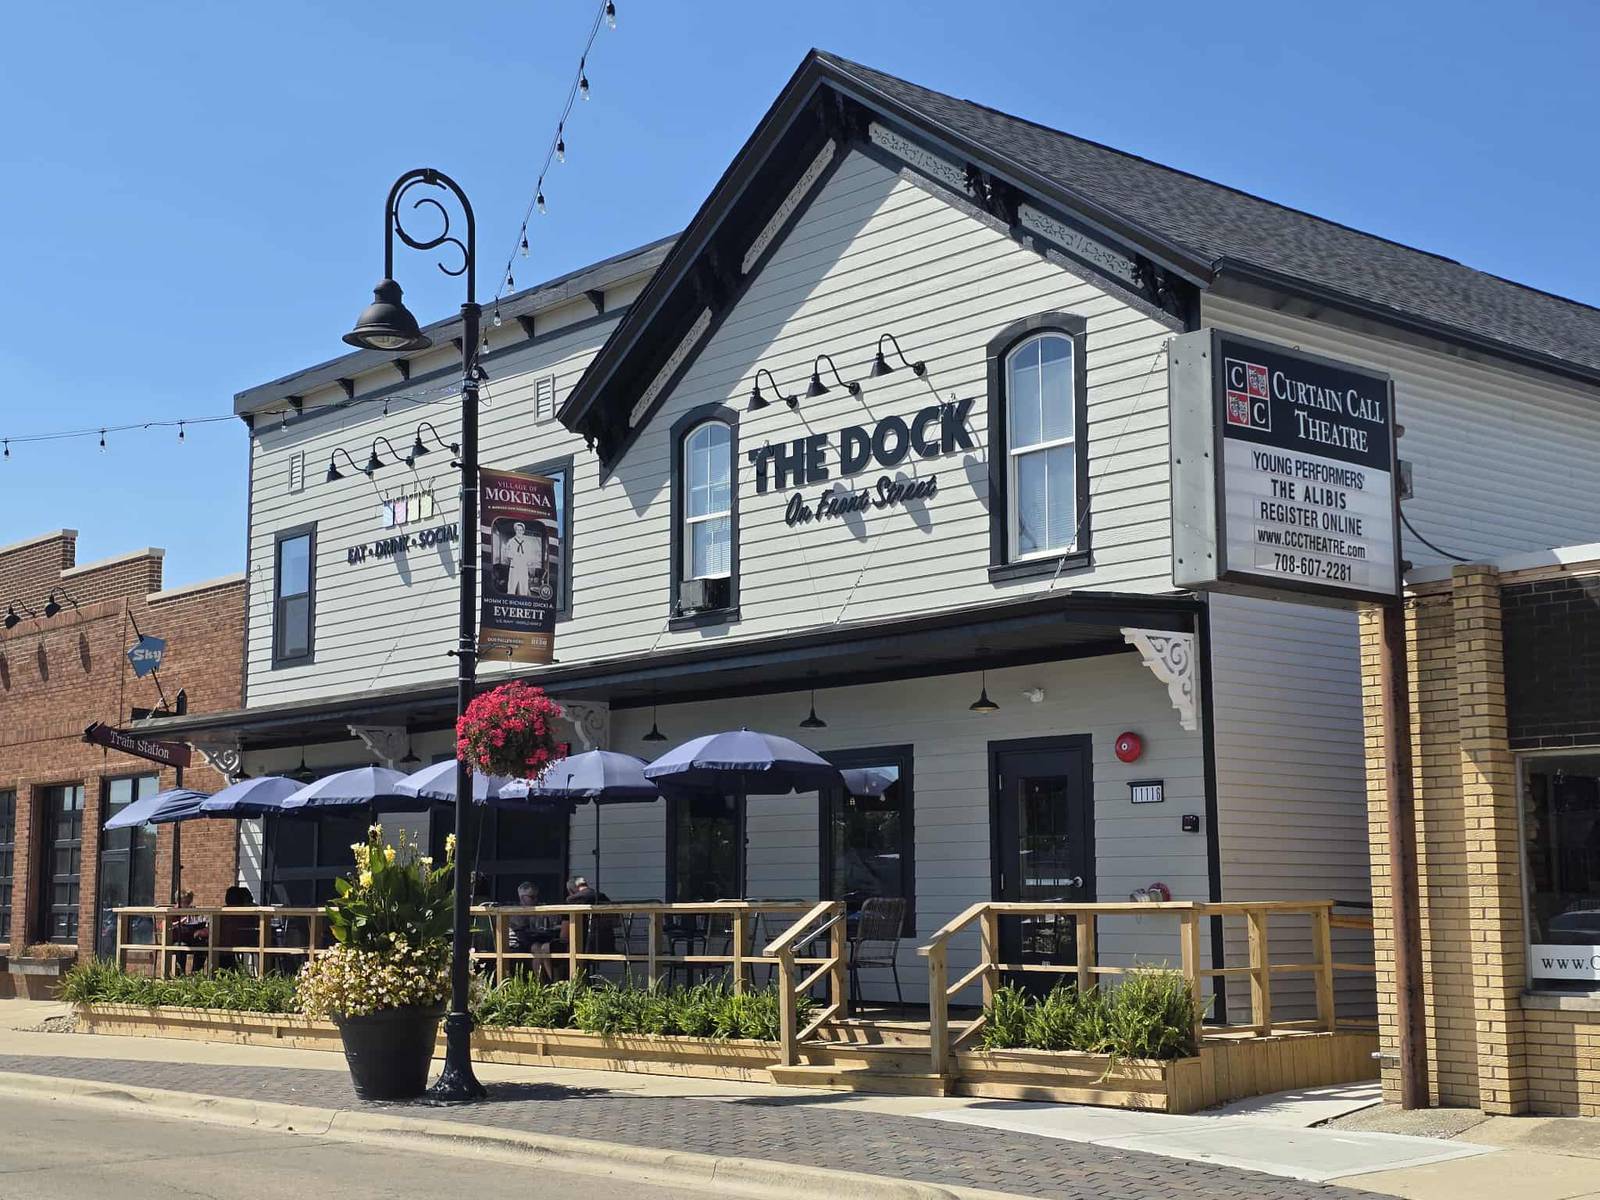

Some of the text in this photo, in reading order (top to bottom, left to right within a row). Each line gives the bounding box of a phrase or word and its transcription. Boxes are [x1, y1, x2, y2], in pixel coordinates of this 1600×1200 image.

[1231, 366, 1244, 388] C
[1273, 371, 1384, 424] CURTAIN CALL
[1253, 402, 1266, 424] C
[1294, 409, 1369, 453] THEATRE
[748, 399, 976, 494] THE DOCK
[1253, 450, 1292, 476] YOUNG
[485, 486, 551, 508] MOKENA
[785, 474, 939, 527] On Front Street
[1270, 478, 1346, 510] THE ALIBIS
[1260, 501, 1362, 536] REGISTER ONLINE
[347, 524, 459, 565] EAT DRINK SOCIAL
[1257, 529, 1366, 559] www.CCCTHEATRE.com
[1274, 553, 1352, 581] 708-607-2281
[493, 605, 546, 620] EVERETT
[133, 649, 162, 663] Sky
[110, 731, 170, 760] Train Station
[1135, 786, 1161, 801] 11116
